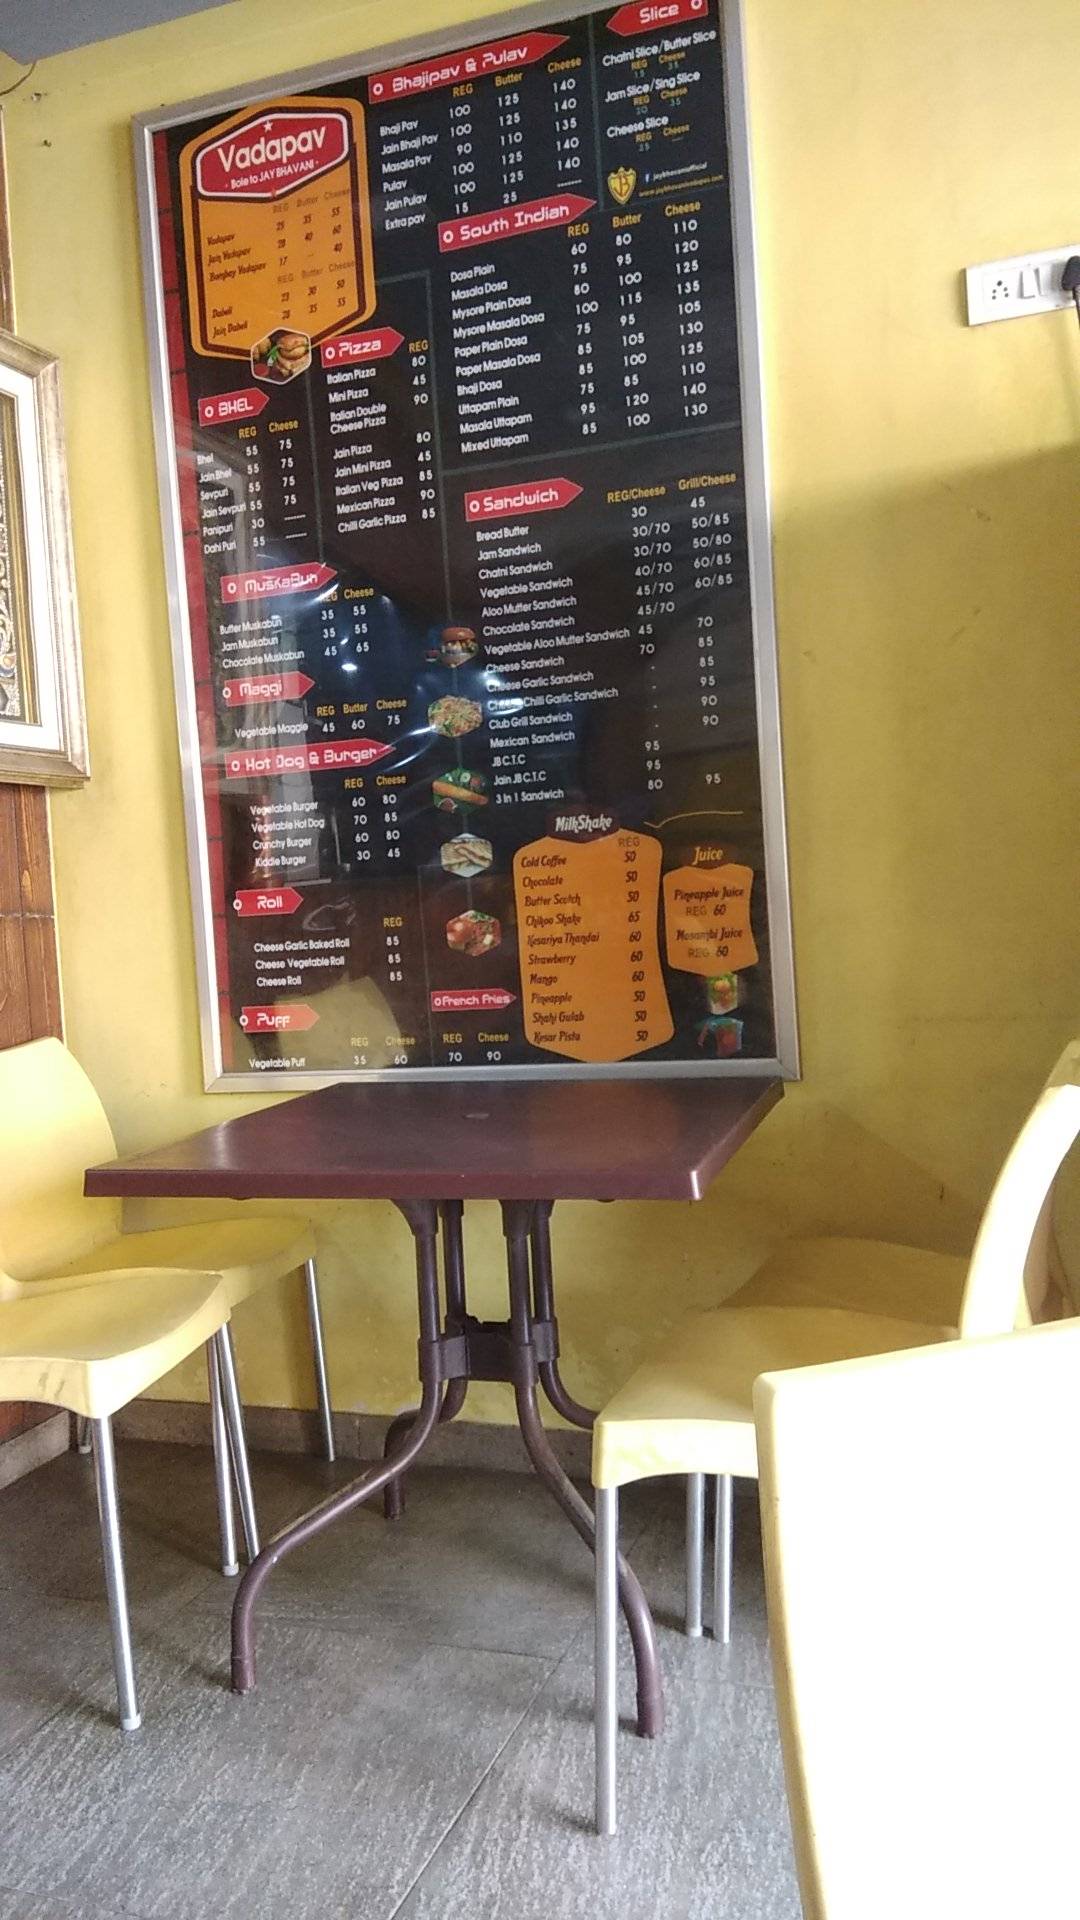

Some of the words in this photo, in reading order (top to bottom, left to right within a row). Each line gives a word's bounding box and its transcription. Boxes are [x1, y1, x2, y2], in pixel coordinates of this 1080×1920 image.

[639, 4, 679, 24] Slice
[602, 49, 634, 67] Chatni
[693, 30, 716, 44] Slice
[392, 65, 459, 92] Bhajipav
[466, 56, 476, 73] &
[482, 45, 528, 68] Pulav
[453, 84, 473, 97] REG
[495, 72, 523, 87] Butter
[548, 58, 582, 74] Cheese
[605, 91, 626, 103] Jam
[676, 71, 700, 84] Slice
[449, 105, 471, 118] 100
[498, 94, 520, 107] 125
[553, 79, 576, 93] 140
[380, 123, 400, 137] Bhaji
[399, 119, 418, 131] Pav
[607, 122, 644, 137] Cheese
[645, 116, 669, 129] Slice
[457, 144, 472, 155] 90
[500, 132, 523, 145] 110
[555, 118, 577, 132] 135
[218, 126, 326, 172] Vadapav
[382, 159, 410, 175] Masala
[410, 154, 432, 168] Pav
[230, 176, 248, 190] Bole
[249, 174, 258, 185] to
[258, 168, 276, 182] JAY
[276, 160, 314, 178] BHAVANI
[383, 179, 408, 192] Pulav
[385, 219, 405, 230] Extra
[405, 214, 425, 229] pav
[460, 220, 509, 241] South
[514, 206, 570, 226] Indian
[568, 224, 590, 236] REG
[612, 213, 642, 228] Butter
[664, 202, 700, 216] Cheese
[571, 243, 587, 255] 60
[616, 234, 632, 246] 80
[674, 220, 698, 234] 110
[573, 263, 588, 275] 75
[616, 254, 632, 266] 95
[674, 240, 698, 254] 120
[450, 269, 474, 282] Dosa
[474, 263, 495, 277] Plain
[452, 285, 484, 300] Masala
[484, 280, 508, 293] Dosa
[452, 305, 485, 320] Mysore
[485, 300, 508, 313] Plain
[508, 294, 531, 308] Dosa
[339, 339, 381, 356] Pizza
[409, 340, 428, 353] REG
[412, 355, 426, 367] 80
[327, 372, 353, 385] Italian
[353, 367, 376, 380] Pizza
[413, 375, 426, 386] 45
[328, 392, 346, 404] Mini
[346, 387, 369, 400] Pizza
[218, 398, 253, 416] BHEL
[458, 400, 498, 415] Uttapam
[498, 396, 519, 409] Plain
[239, 427, 256, 439] REG
[269, 420, 299, 432] Cheese
[246, 446, 258, 456] 55
[280, 439, 292, 450] 75
[460, 440, 490, 453] Mixed
[490, 432, 528, 449] Uttapam
[607, 485, 666, 503] REG/Cheese
[678, 472, 737, 490] Grill/Cheese
[337, 502, 373, 515] Mexican
[373, 496, 395, 509] Pizza
[483, 488, 559, 511] Sandwich
[632, 506, 647, 518] 30
[691, 497, 705, 508] 45
[203, 523, 233, 537] Panipuri
[252, 519, 265, 529] 30
[338, 521, 358, 533] Chilli
[358, 516, 384, 529] Garlic
[384, 513, 407, 525] Pizza
[633, 522, 670, 538] 30/70
[692, 513, 730, 529] 50/85
[476, 529, 502, 542] Bread
[503, 525, 529, 538] Butter
[479, 567, 509, 580] Chatni
[509, 560, 553, 575] Sandwich
[344, 587, 374, 600] Cheese
[480, 583, 528, 599] Vegetable
[528, 576, 573, 592] Sandwich
[322, 610, 334, 620] 35
[353, 606, 366, 616] 55
[481, 606, 503, 617] Aloo
[503, 601, 532, 615] Mutter
[532, 596, 577, 611] Sandwich
[223, 655, 264, 668] Chocolate
[264, 649, 304, 662] Muskabun
[240, 680, 282, 697] Maggi
[317, 706, 335, 716] REG
[343, 702, 368, 714] Butter
[376, 698, 407, 710] Cheese
[235, 726, 276, 740] Vegetable
[276, 721, 308, 735] Maggie
[322, 722, 335, 733] 45
[352, 719, 366, 730] 60
[388, 715, 400, 726] 75
[489, 719, 510, 730] Club
[511, 716, 529, 728] Grill
[529, 712, 573, 725] Sandwich
[490, 736, 530, 749] Mexican
[532, 730, 575, 745] Sandwich
[246, 756, 271, 771] Hot
[276, 753, 304, 769] Dog
[310, 752, 318, 764] &
[324, 748, 377, 764] Burger
[344, 778, 364, 789] REG
[376, 774, 406, 786] Cheese
[250, 803, 292, 816] Vegetable
[292, 800, 318, 814] Burger
[352, 796, 366, 806] 60
[382, 794, 396, 804] 80
[555, 813, 612, 832] MilkShake
[618, 838, 640, 847] REG
[521, 856, 539, 867] Cold
[540, 854, 567, 867] Coffee
[624, 851, 636, 862] 50
[693, 847, 723, 865] Juice
[257, 895, 283, 909] Roll
[674, 888, 719, 903] Pineapple
[721, 886, 744, 900] Juice
[384, 917, 403, 928] REG
[254, 943, 284, 953] Cheese
[284, 941, 309, 951] Garlic
[309, 940, 335, 950] Baked
[335, 939, 350, 948] Roll
[387, 937, 399, 947] 85
[528, 954, 576, 966] Strawberry
[631, 951, 643, 962] 60
[441, 997, 479, 1006] French
[482, 993, 512, 1005] Fries
[256, 1013, 291, 1027] Puff
[351, 1037, 368, 1047] REG
[385, 1035, 416, 1046] Cheese
[443, 1033, 462, 1043] REG
[478, 1032, 509, 1042] Cheese
[249, 1058, 290, 1069] Vegetable
[291, 1057, 306, 1067] Puff
[354, 1056, 367, 1065] 35
[395, 1054, 408, 1064] 60
[449, 1052, 463, 1062] 70
[487, 1051, 501, 1061] 90
